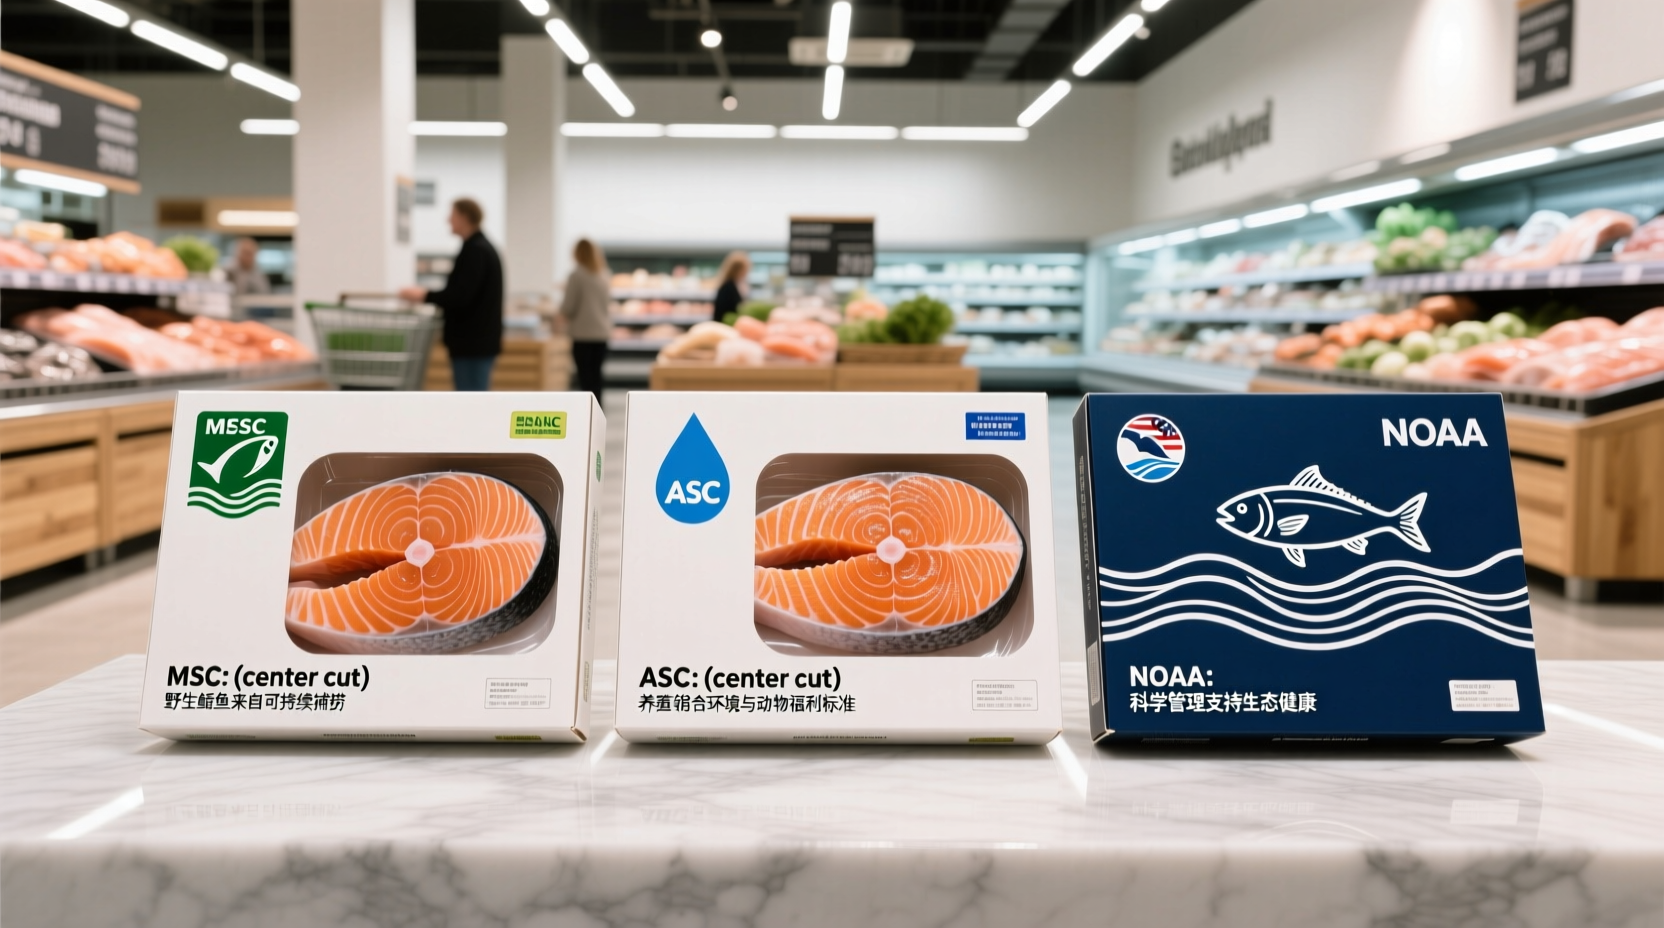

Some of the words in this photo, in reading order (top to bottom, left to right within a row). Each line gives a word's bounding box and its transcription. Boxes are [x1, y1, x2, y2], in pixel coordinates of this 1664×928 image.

[1381, 417, 1489, 447] NOAA
[664, 481, 721, 505] ASC
[166, 665, 229, 687] MSC:
[233, 664, 319, 692] (center
[323, 664, 370, 692] cut)
[638, 665, 699, 688] ASC:
[704, 665, 790, 692] (center
[794, 665, 842, 692] cut)
[1129, 665, 1214, 687] NOAA:
[1129, 690, 1318, 713] 科学管理支持生态健康
